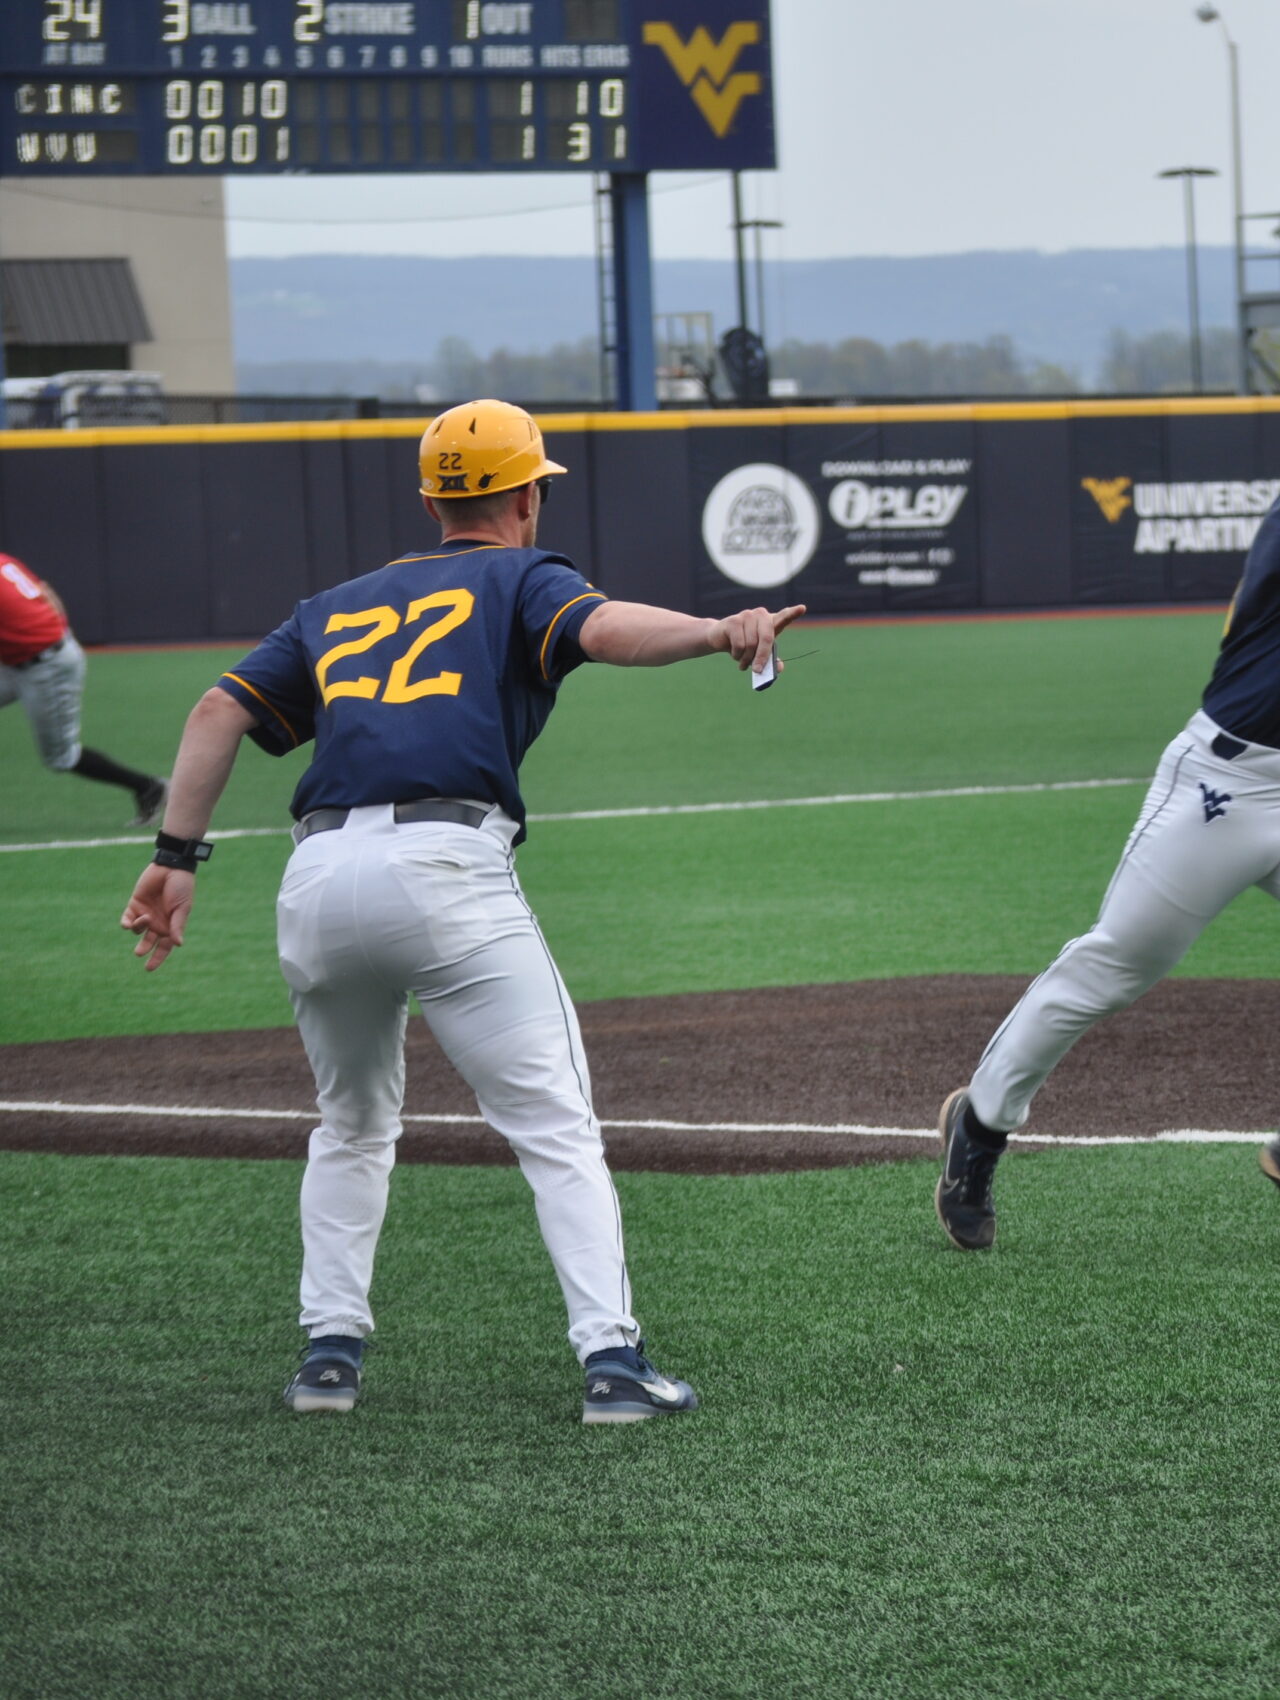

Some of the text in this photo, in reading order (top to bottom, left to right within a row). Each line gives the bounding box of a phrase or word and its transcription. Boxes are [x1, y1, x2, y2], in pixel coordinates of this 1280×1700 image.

[43, 0, 101, 40] 24
[162, 0, 189, 41] 3
[294, 0, 416, 41] 2 STRIKE
[481, 3, 532, 34] OUT
[201, 46, 217, 68] 2
[233, 46, 249, 68] 3
[358, 46, 376, 68] 7
[438, 453, 462, 470] 22
[315, 588, 475, 711] 22
